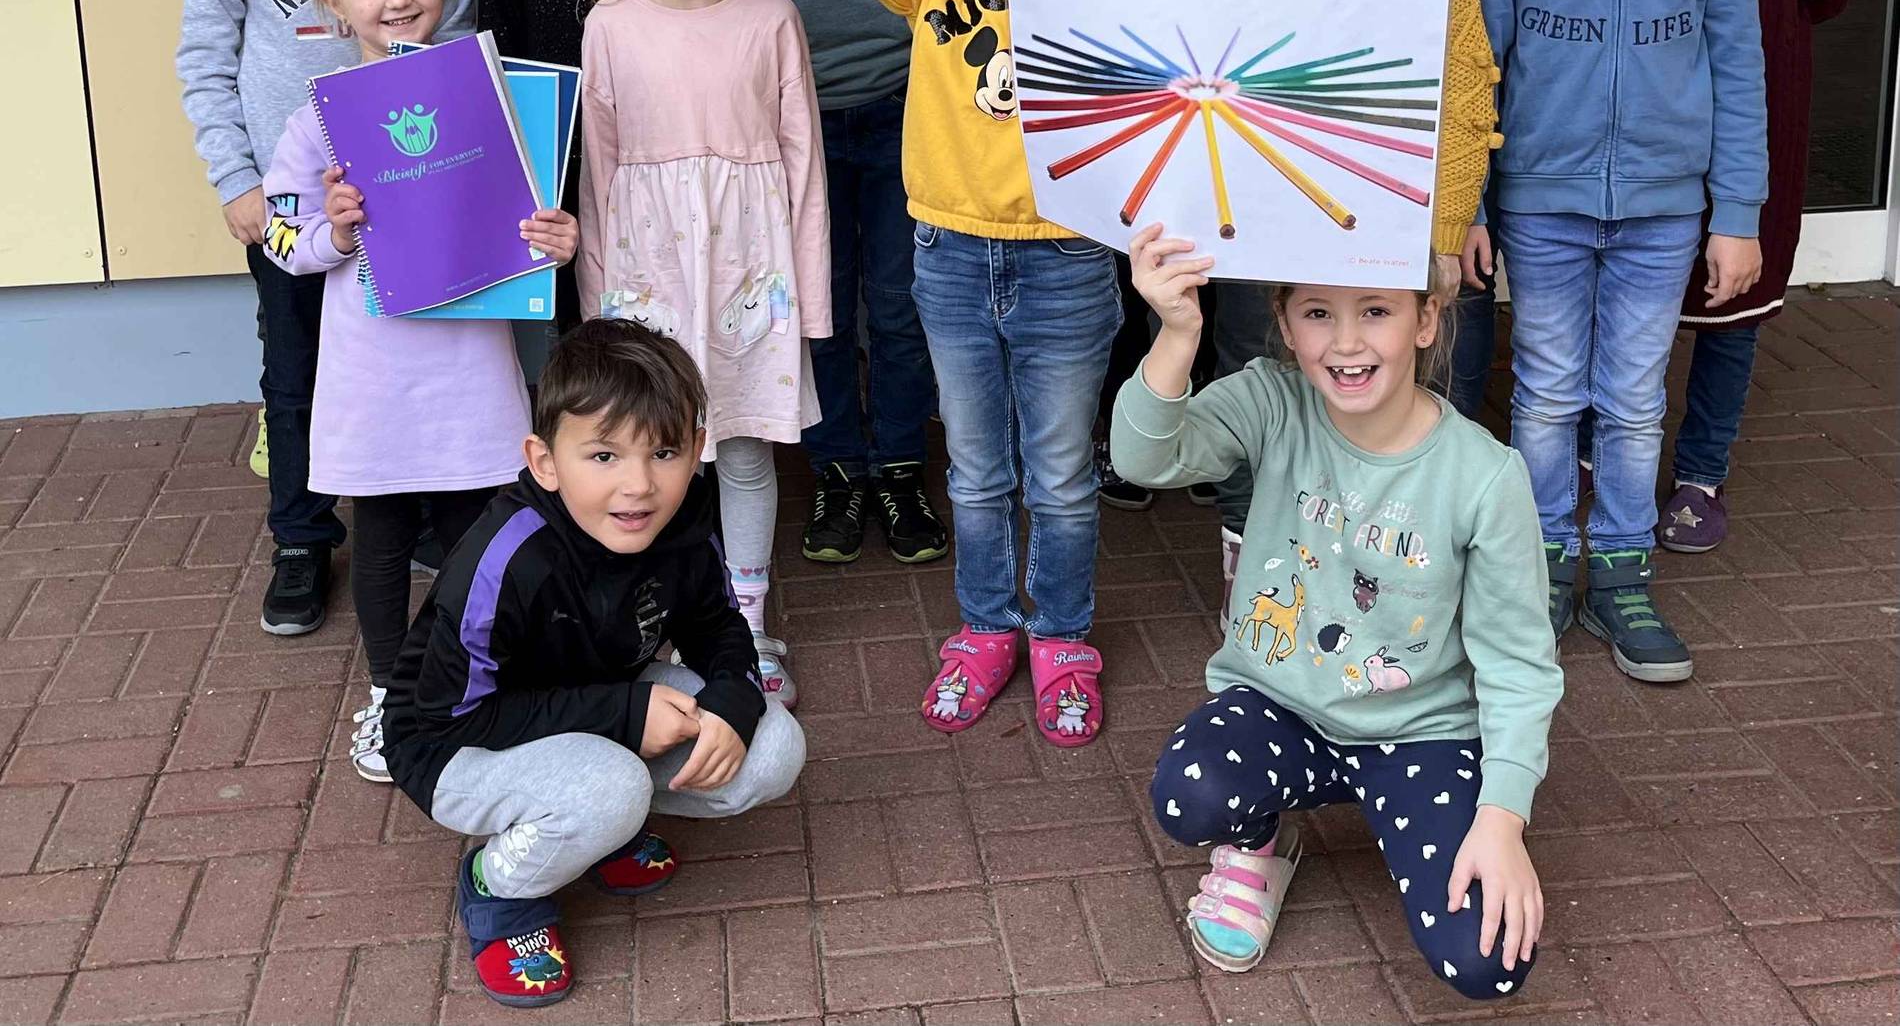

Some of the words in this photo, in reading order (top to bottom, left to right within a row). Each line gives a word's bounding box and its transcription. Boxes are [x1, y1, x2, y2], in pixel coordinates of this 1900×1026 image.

[1520, 6, 1607, 43] GREEN
[373, 161, 427, 183] Bleistift
[429, 159, 445, 170] FOR
[445, 146, 484, 166] EVERYONE
[1296, 490, 1351, 537] FOREST
[1353, 523, 1424, 559] FRIEND
[1053, 651, 1097, 667] Rainbow
[514, 933, 550, 958] DINO
